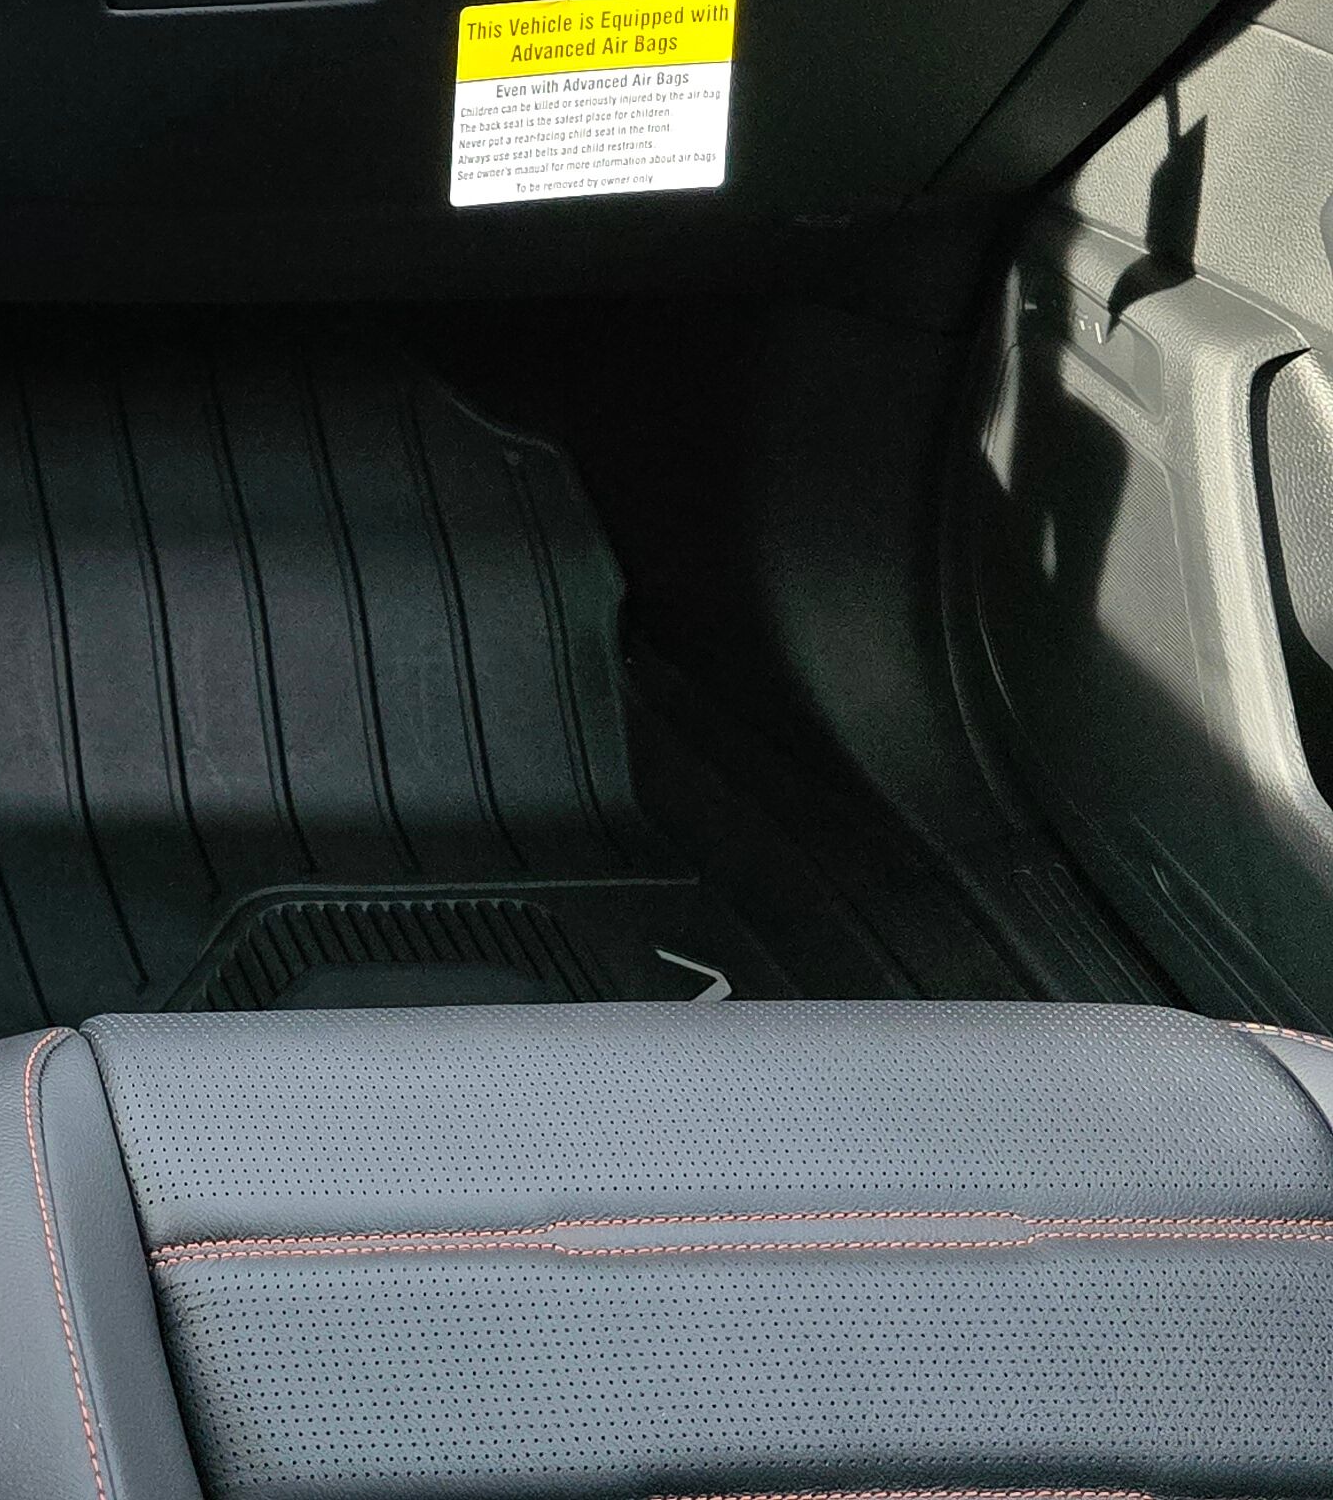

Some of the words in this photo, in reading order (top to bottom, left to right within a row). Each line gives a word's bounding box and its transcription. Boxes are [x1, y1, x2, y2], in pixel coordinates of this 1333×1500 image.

[467, 21, 503, 40] This
[509, 14, 572, 36] Vehicle
[579, 13, 594, 30] is
[601, 6, 684, 31] Equipped
[691, 4, 729, 22] with
[511, 38, 595, 62] Advanced
[602, 36, 628, 54] Air
[634, 35, 678, 55] Bags
[496, 84, 527, 98] Even
[531, 79, 559, 94] with
[563, 74, 628, 92] Advanced
[632, 72, 652, 87] Air
[656, 71, 690, 87] Bags
[460, 106, 499, 118] Children
[501, 104, 518, 114] can
[520, 103, 531, 112] be
[534, 100, 560, 111] killed
[562, 100, 572, 108] or
[574, 94, 617, 107] seriously
[620, 93, 653, 106] injured
[655, 92, 667, 103] by
[669, 91, 685, 101] the
[687, 90, 700, 100] air
[460, 123, 477, 133] The
[479, 121, 501, 132] back
[503, 119, 524, 129] seat
[526, 117, 535, 127] is
[537, 116, 552, 126] the
[554, 114, 583, 125] safest
[586, 112, 612, 124] place
[614, 110, 628, 120] for
[458, 139, 486, 149] Never
[488, 136, 504, 148] put
[505, 137, 512, 145] a
[514, 131, 566, 144] rear-facing
[568, 128, 592, 139] child
[594, 126, 615, 137] seat
[617, 125, 627, 135] in
[629, 124, 645, 134] the
[457, 154, 491, 165] Always
[493, 152, 510, 162] use
[512, 149, 532, 160] seat
[535, 147, 558, 158] belts
[560, 145, 578, 155] and
[581, 142, 605, 153] child
[457, 171, 474, 181] See
[476, 167, 512, 179] owner's
[514, 163, 549, 175] manual
[551, 162, 564, 172] for
[566, 160, 590, 170] more
[592, 156, 647, 168] information
[649, 154, 676, 164] about
[678, 154, 691, 163] air
[516, 183, 527, 193] To
[529, 183, 541, 192] be
[543, 178, 584, 191] removed
[587, 177, 598, 188] by
[600, 176, 631, 186] owner
[632, 174, 654, 184] only
